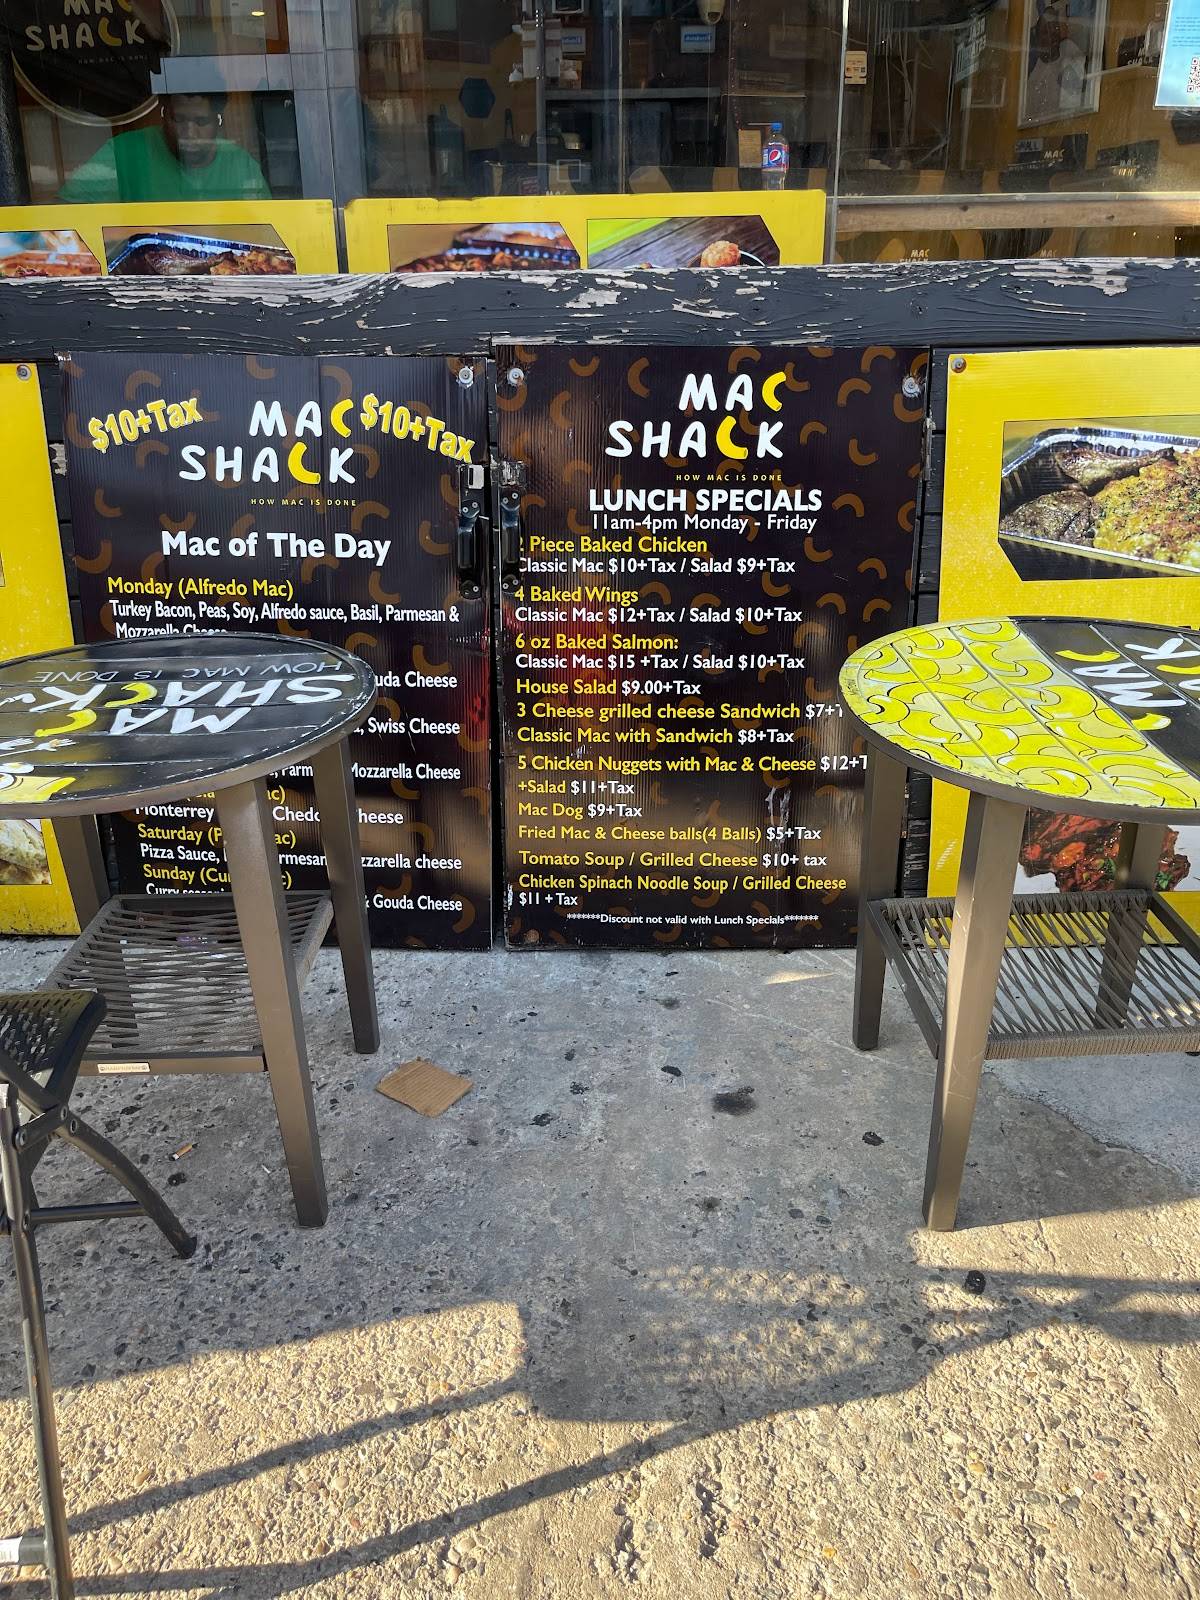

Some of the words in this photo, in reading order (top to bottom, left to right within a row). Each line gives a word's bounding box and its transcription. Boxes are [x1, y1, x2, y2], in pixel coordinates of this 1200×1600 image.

[25, 16, 145, 51] SHACK
[910, 249, 930, 257] MAC
[679, 371, 787, 411] MAC
[88, 398, 203, 453] $10+Tax
[249, 399, 354, 438] MAC
[360, 393, 475, 463] $10+Tax
[605, 415, 783, 459] SHACK
[179, 442, 355, 484] SHACK
[327, 499, 356, 507] DONE
[589, 489, 687, 511] LUNCH
[696, 489, 822, 511] SPECIALS
[593, 513, 677, 534] 11am-4pm
[684, 514, 748, 534] Monday
[767, 514, 817, 533] Friday
[162, 531, 220, 556] Mac
[229, 532, 258, 557] of
[267, 532, 325, 558] The
[334, 533, 391, 566] Day
[530, 536, 574, 552] Piece
[580, 536, 633, 552] Baked
[638, 536, 707, 552] Chicken
[572, 557, 604, 572] Mac
[608, 557, 676, 575] $10+Tax
[680, 558, 687, 572] /
[690, 557, 732, 572] Salad
[737, 557, 795, 575] $9+Tax
[107, 577, 173, 599] Monday
[178, 577, 247, 599] (Alfredo
[253, 579, 293, 601] Mac)
[514, 586, 524, 602] 4
[530, 586, 581, 602] Baked
[585, 586, 639, 606] Wings
[109, 600, 152, 621] Turkey
[155, 601, 196, 620] Bacon,
[199, 601, 230, 620] Peas,
[233, 602, 259, 623] Soy,
[261, 602, 306, 620] Alfredo
[310, 608, 347, 622] sauce,
[351, 604, 382, 623] Basil,
[386, 604, 445, 621] Parmesan
[449, 606, 460, 622] &
[515, 607, 567, 622] Classic
[572, 607, 603, 622] Mac
[608, 607, 675, 624] $12+Tax
[679, 608, 686, 622] /
[690, 607, 730, 622] Salad
[735, 607, 802, 624] $10+Tax
[515, 633, 525, 648] 6
[531, 637, 550, 649] oz
[556, 633, 606, 649] Baked
[612, 633, 679, 649] Salmon:
[259, 661, 343, 676] HOW
[515, 654, 567, 668] Classic
[572, 654, 603, 668] Mac
[608, 654, 635, 670] $15
[640, 654, 679, 668] +Tax
[682, 655, 688, 668] /
[693, 654, 733, 668] Salad
[738, 654, 805, 670] $10+Tax
[28, 670, 119, 683] DONE
[134, 670, 162, 680] IS
[182, 665, 252, 679] MAC
[375, 671, 401, 687] uda
[405, 671, 458, 688] Cheese
[29, 674, 355, 713] SHACK
[516, 679, 569, 694] House
[573, 679, 617, 694] Salad
[621, 680, 701, 696] $9.00+Tax
[517, 702, 526, 717] 3
[532, 702, 594, 718] Cheese
[599, 703, 652, 722] grilled
[657, 703, 715, 718] cheese
[720, 703, 800, 718] Sandwich
[34, 706, 252, 738] MAC
[368, 717, 405, 733] Swiss
[409, 718, 460, 734] Cheese
[517, 727, 572, 742] Classic
[577, 727, 610, 742] Mac
[615, 728, 651, 742] with
[656, 728, 733, 743] Sandwich
[738, 728, 794, 745] $8+Tax
[416, 763, 461, 779] Cheese
[518, 756, 526, 770] 5
[531, 756, 594, 770] Chicken
[598, 756, 662, 775] Nuggets
[666, 756, 700, 771] with
[705, 756, 737, 771] Mac
[741, 757, 754, 771] &
[758, 756, 816, 771] Cheese
[518, 780, 566, 794] +Salad
[570, 780, 634, 795] $11+Tax
[357, 808, 404, 824] heese
[518, 802, 548, 816] Mac
[552, 803, 583, 820] Dog
[587, 803, 642, 818] $9+Tax
[137, 823, 202, 845] Saturday
[518, 825, 556, 839] Fried
[561, 826, 590, 839] Mac
[594, 827, 607, 840] &
[611, 826, 665, 840] Cheese
[670, 827, 717, 844] balls(4
[721, 827, 762, 843] Balls)
[766, 827, 821, 841] $5+Tax
[140, 843, 175, 859] Pizza
[177, 846, 220, 864] Sauce,
[278, 854, 328, 866] rmesan
[361, 853, 411, 868] zzarella
[415, 854, 462, 869] cheese
[518, 850, 580, 865] Tomato
[584, 851, 624, 869] Soup
[628, 852, 635, 866] /
[639, 852, 694, 866] Grilled
[699, 852, 758, 867] Cheese
[762, 853, 799, 868] $10+
[804, 855, 827, 866] tax
[143, 864, 195, 884] Sunday
[518, 874, 575, 889] Chicken
[579, 875, 632, 892] Spinach
[637, 876, 689, 890] Noodle
[693, 876, 729, 894] Soup
[732, 876, 738, 890] /
[742, 876, 791, 890] Grilled
[795, 876, 847, 890] Cheese
[373, 894, 414, 910] Gouda
[417, 895, 462, 910] Cheese
[519, 892, 540, 906] $11
[556, 892, 578, 905] Tax
[646, 915, 662, 924] not
[665, 915, 687, 924] valid
[690, 915, 711, 924] with
[714, 915, 744, 924] Lunch
